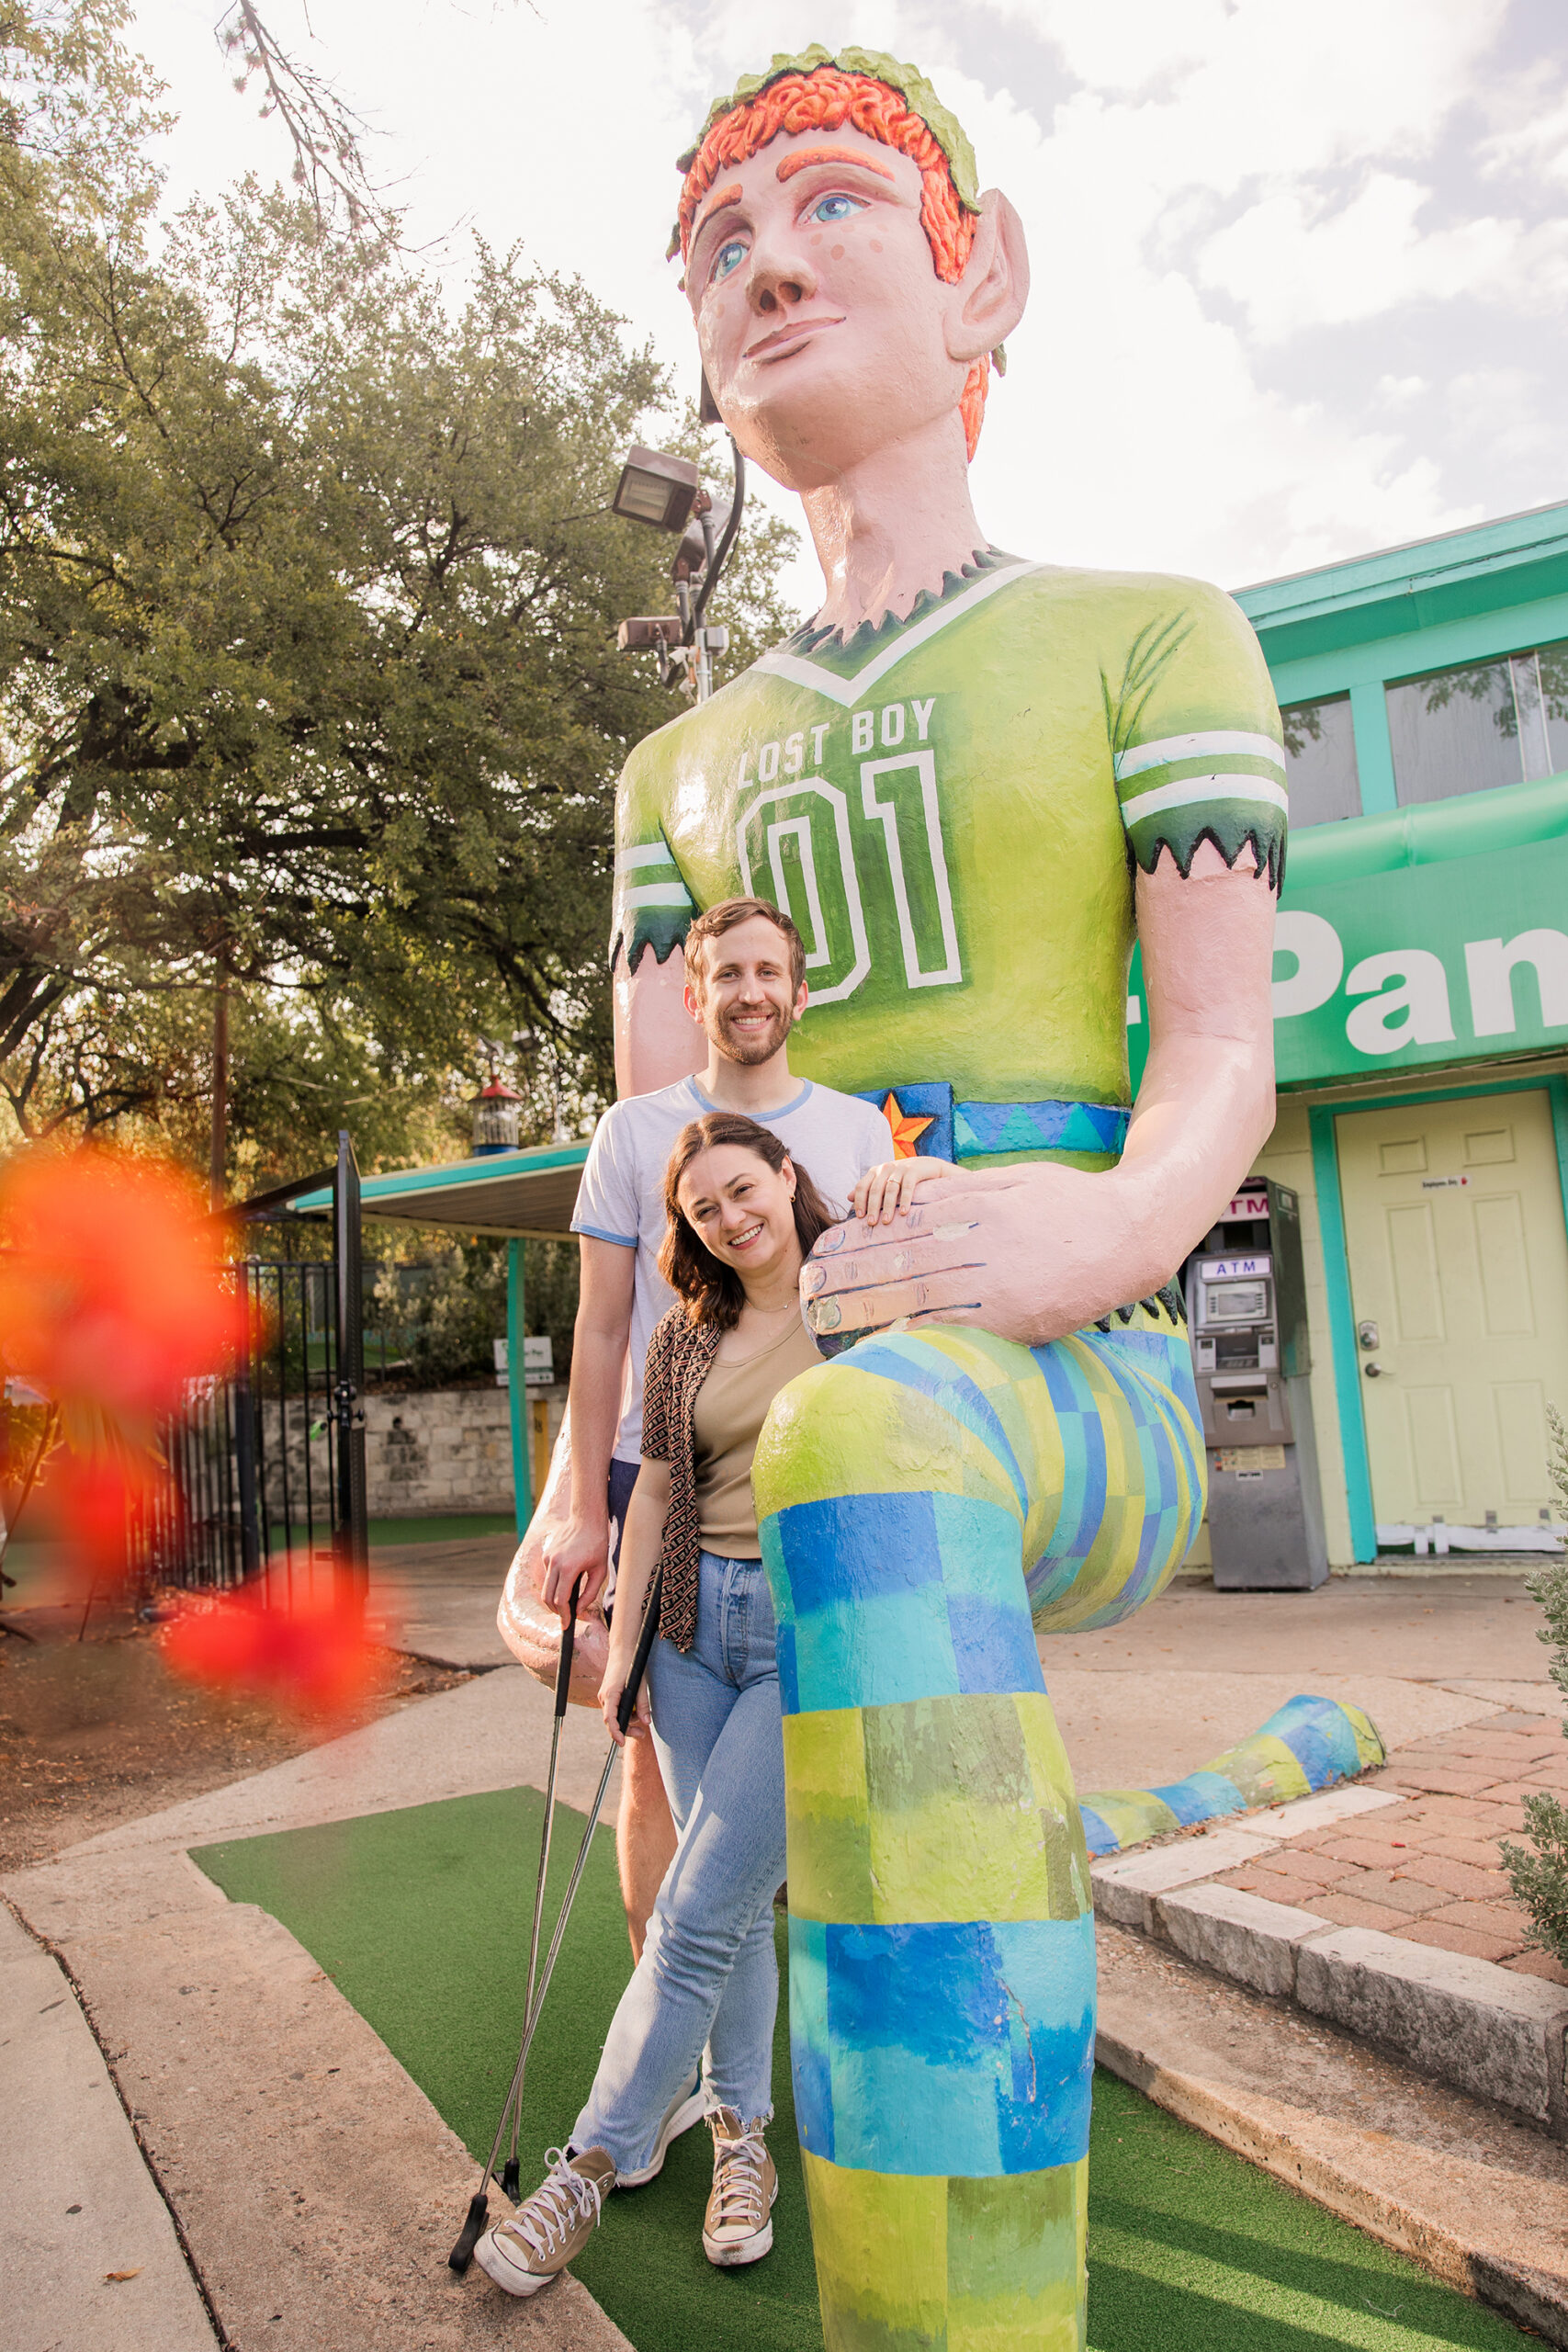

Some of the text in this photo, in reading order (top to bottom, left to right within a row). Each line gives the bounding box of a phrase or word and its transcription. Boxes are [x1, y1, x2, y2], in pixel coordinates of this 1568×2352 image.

[738, 697, 936, 790] LOST BOY
[736, 749, 963, 1008] 01
[1271, 910, 1568, 1056] Pan
[1224, 1197, 1269, 1216] TM
[1217, 1261, 1256, 1275] ATM
